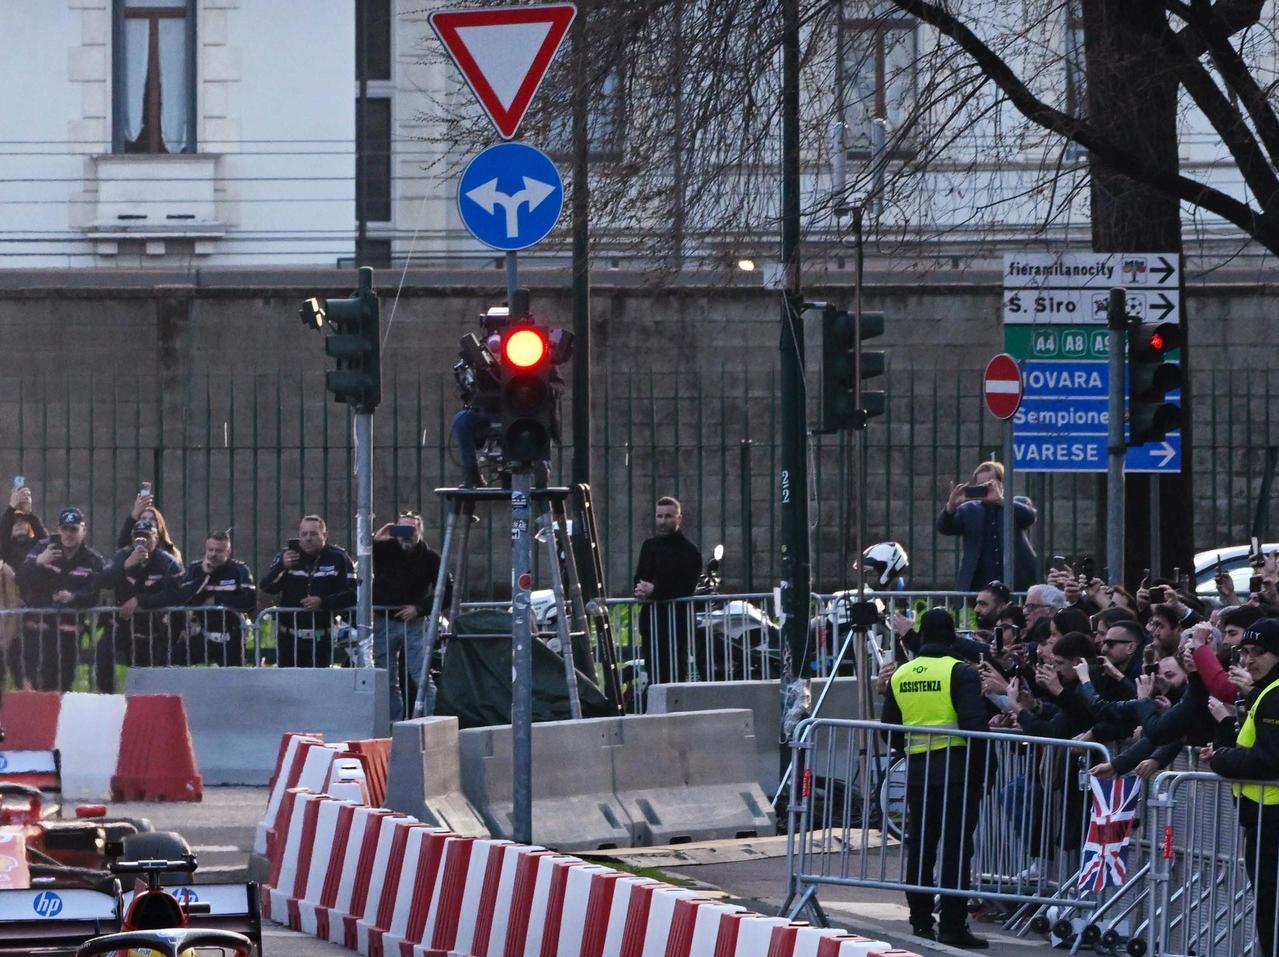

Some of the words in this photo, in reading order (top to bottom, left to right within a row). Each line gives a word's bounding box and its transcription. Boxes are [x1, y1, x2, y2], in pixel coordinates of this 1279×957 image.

[1009, 261, 1114, 279] fieramilanocity
[1009, 297, 1027, 313] S.
[1035, 297, 1076, 313] Siro
[1035, 336, 1054, 351] A4
[1065, 336, 1083, 351] A8
[1013, 407, 1110, 427] Sempione
[1013, 444, 1099, 461] VARESE
[899, 680, 942, 693] ASSISTENZA
[35, 891, 61, 917] hp
